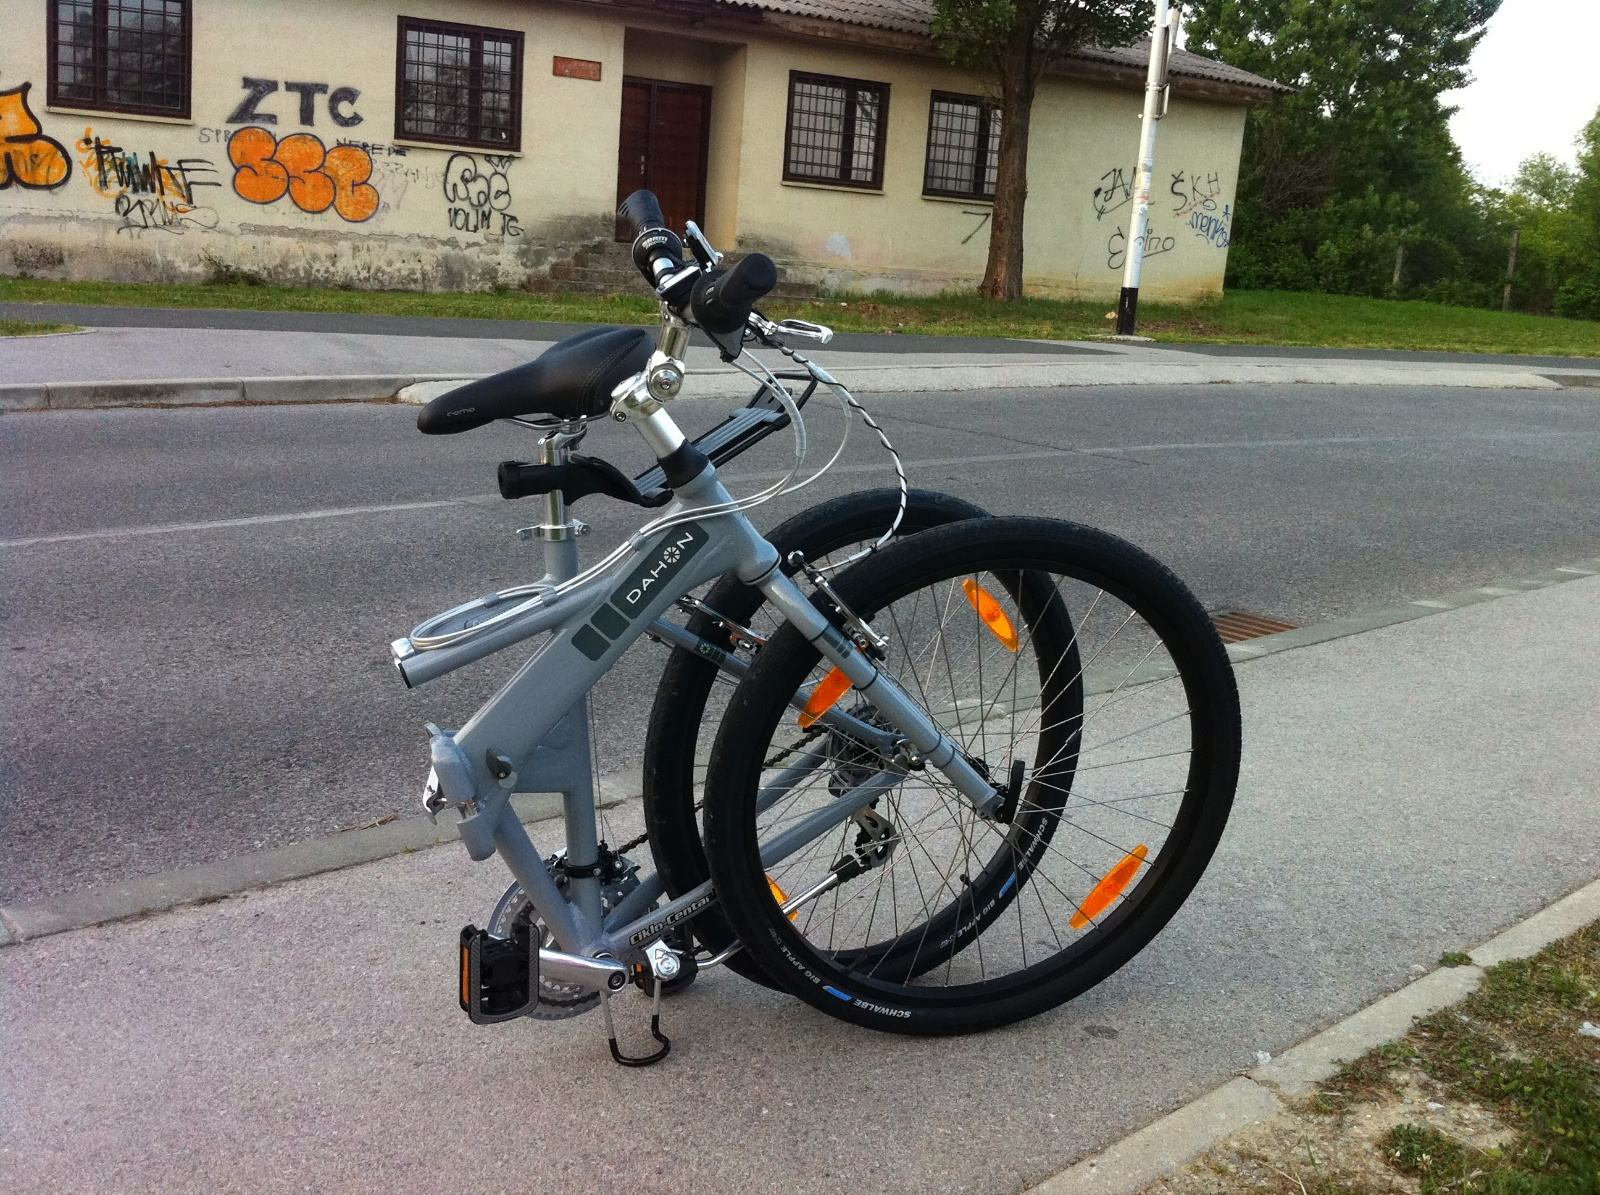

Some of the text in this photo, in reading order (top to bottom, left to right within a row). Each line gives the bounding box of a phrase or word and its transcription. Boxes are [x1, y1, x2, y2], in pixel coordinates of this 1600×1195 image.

[226, 77, 364, 127] ZTC
[626, 532, 694, 604] DAHON
[780, 945, 912, 1018] SCHWALBE BIG APPLE
